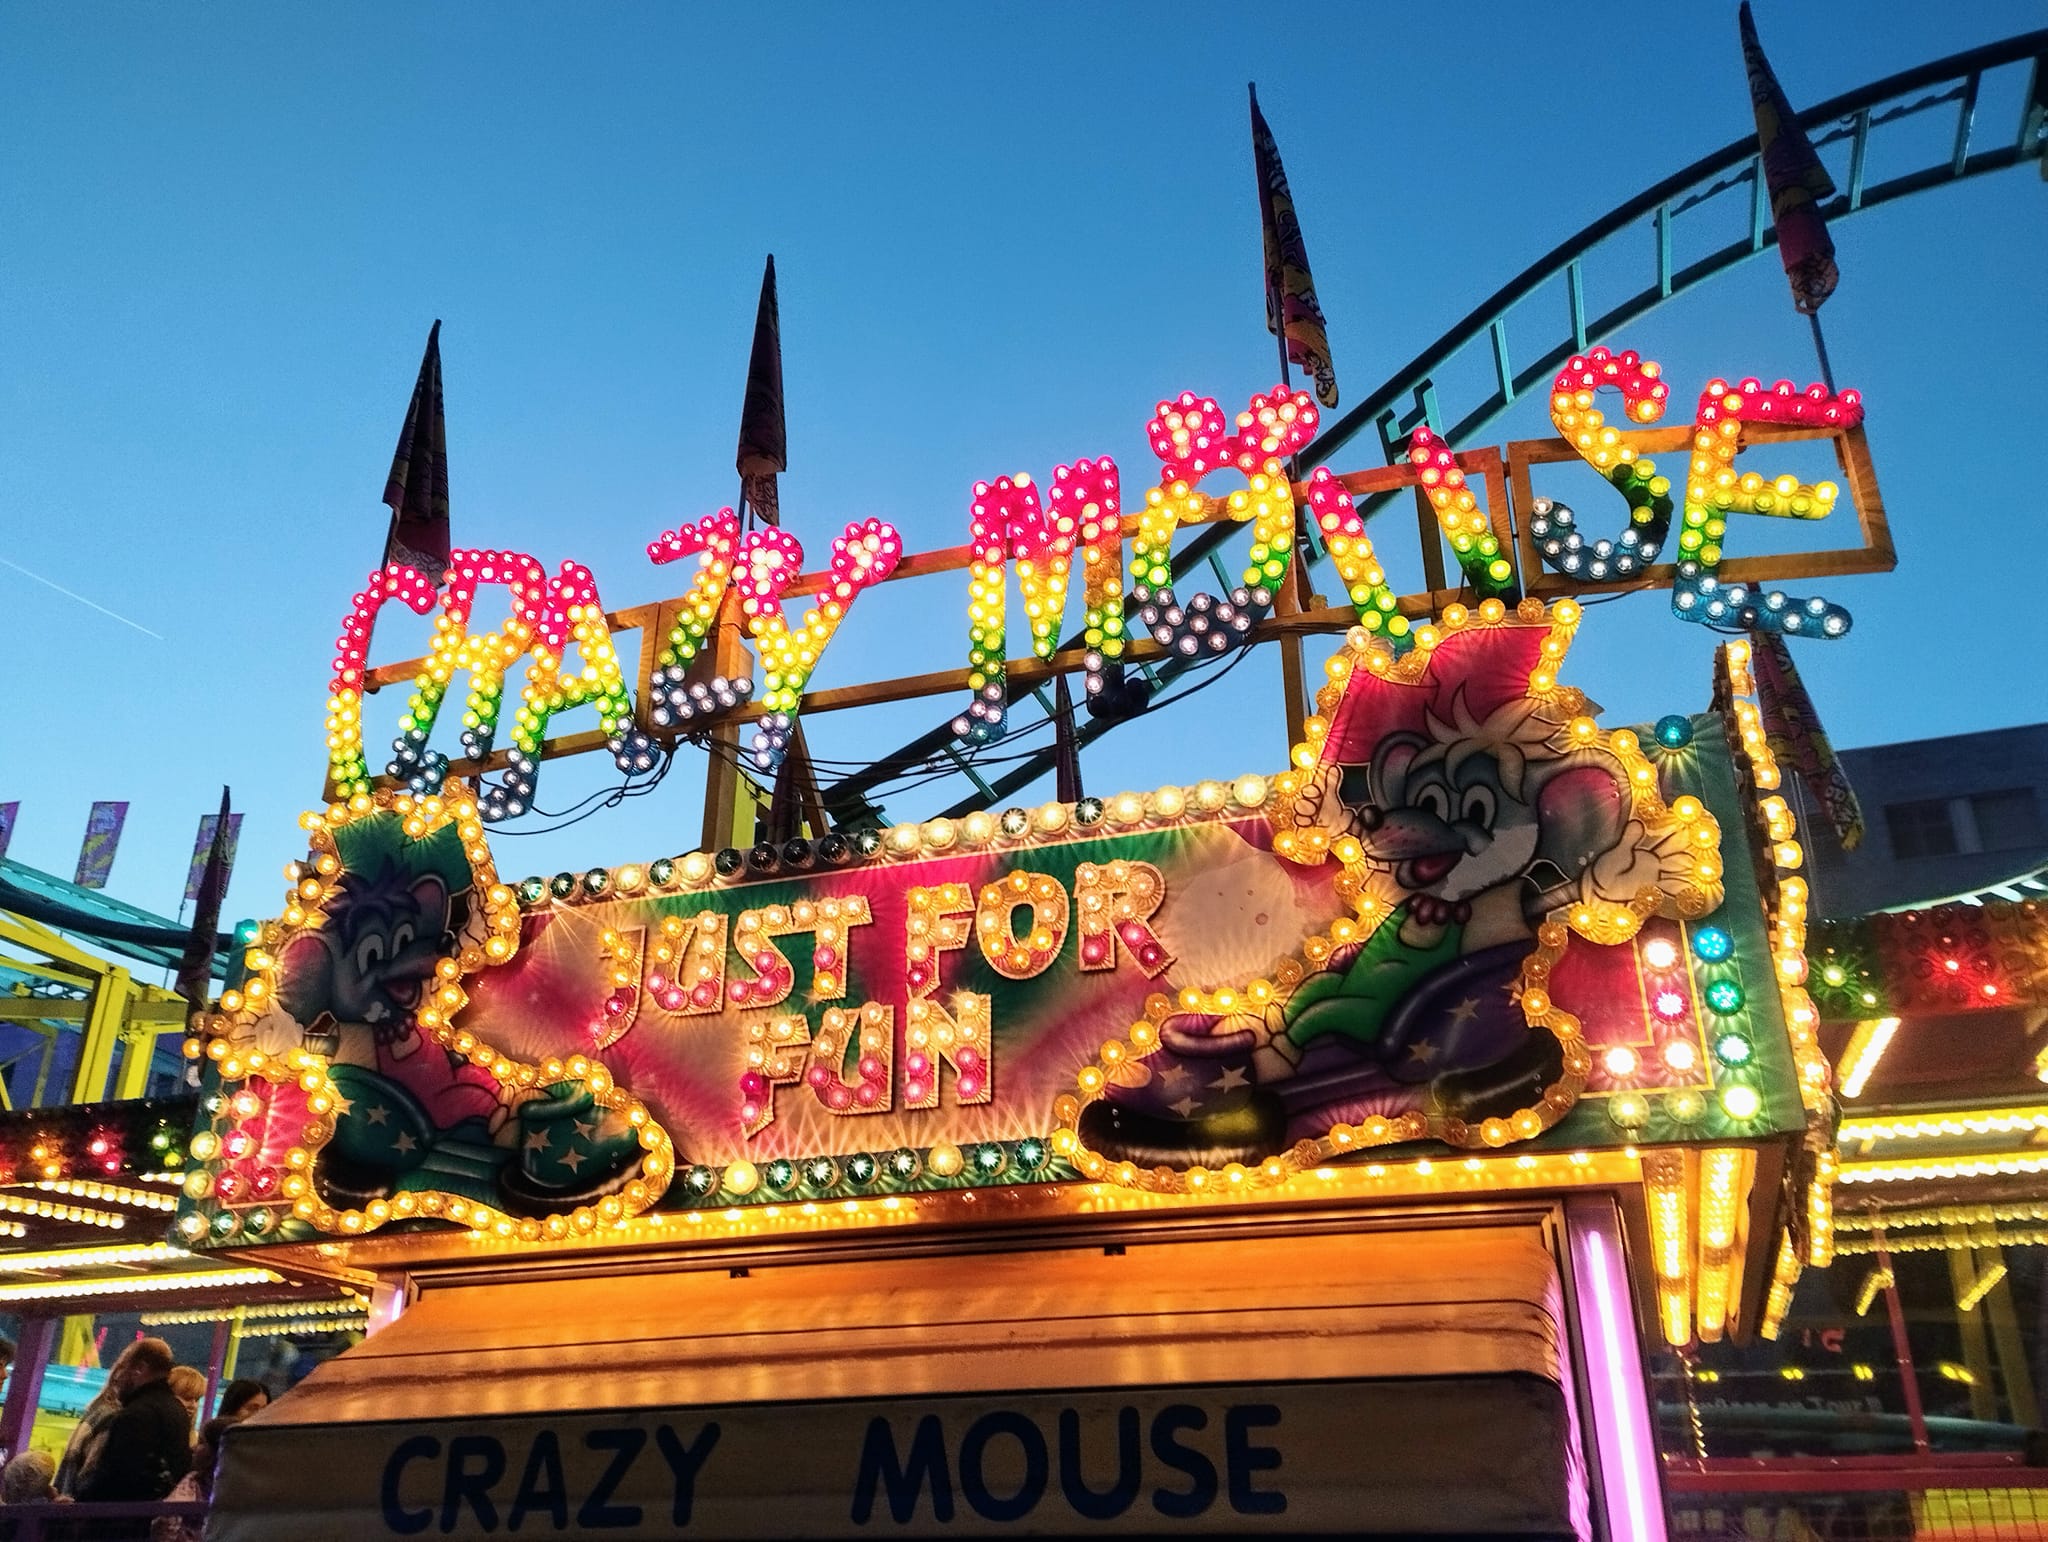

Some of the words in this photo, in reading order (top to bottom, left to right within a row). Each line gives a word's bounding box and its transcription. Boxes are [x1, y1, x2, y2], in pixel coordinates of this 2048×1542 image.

[325, 506, 903, 822] CRAZY
[950, 346, 1864, 747] MOUSE
[589, 895, 874, 1050] JUST
[907, 859, 1177, 998] FOR
[739, 993, 992, 1140] FUN
[380, 1421, 721, 1534] CRAZY
[849, 1404, 1288, 1525] MOUSE
